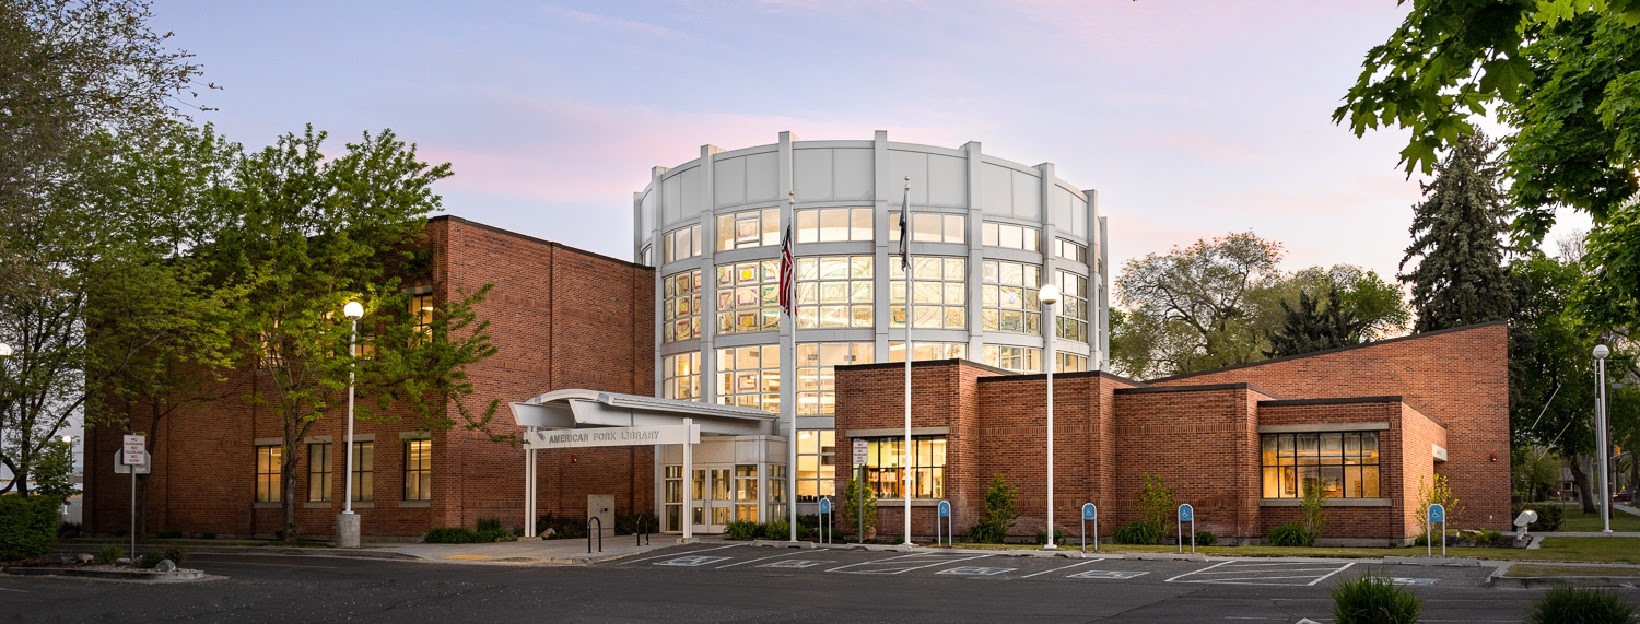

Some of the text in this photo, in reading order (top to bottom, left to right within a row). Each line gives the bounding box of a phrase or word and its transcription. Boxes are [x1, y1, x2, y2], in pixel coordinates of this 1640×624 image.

[549, 430, 660, 444] AMERICAN FORK LIBRARY
